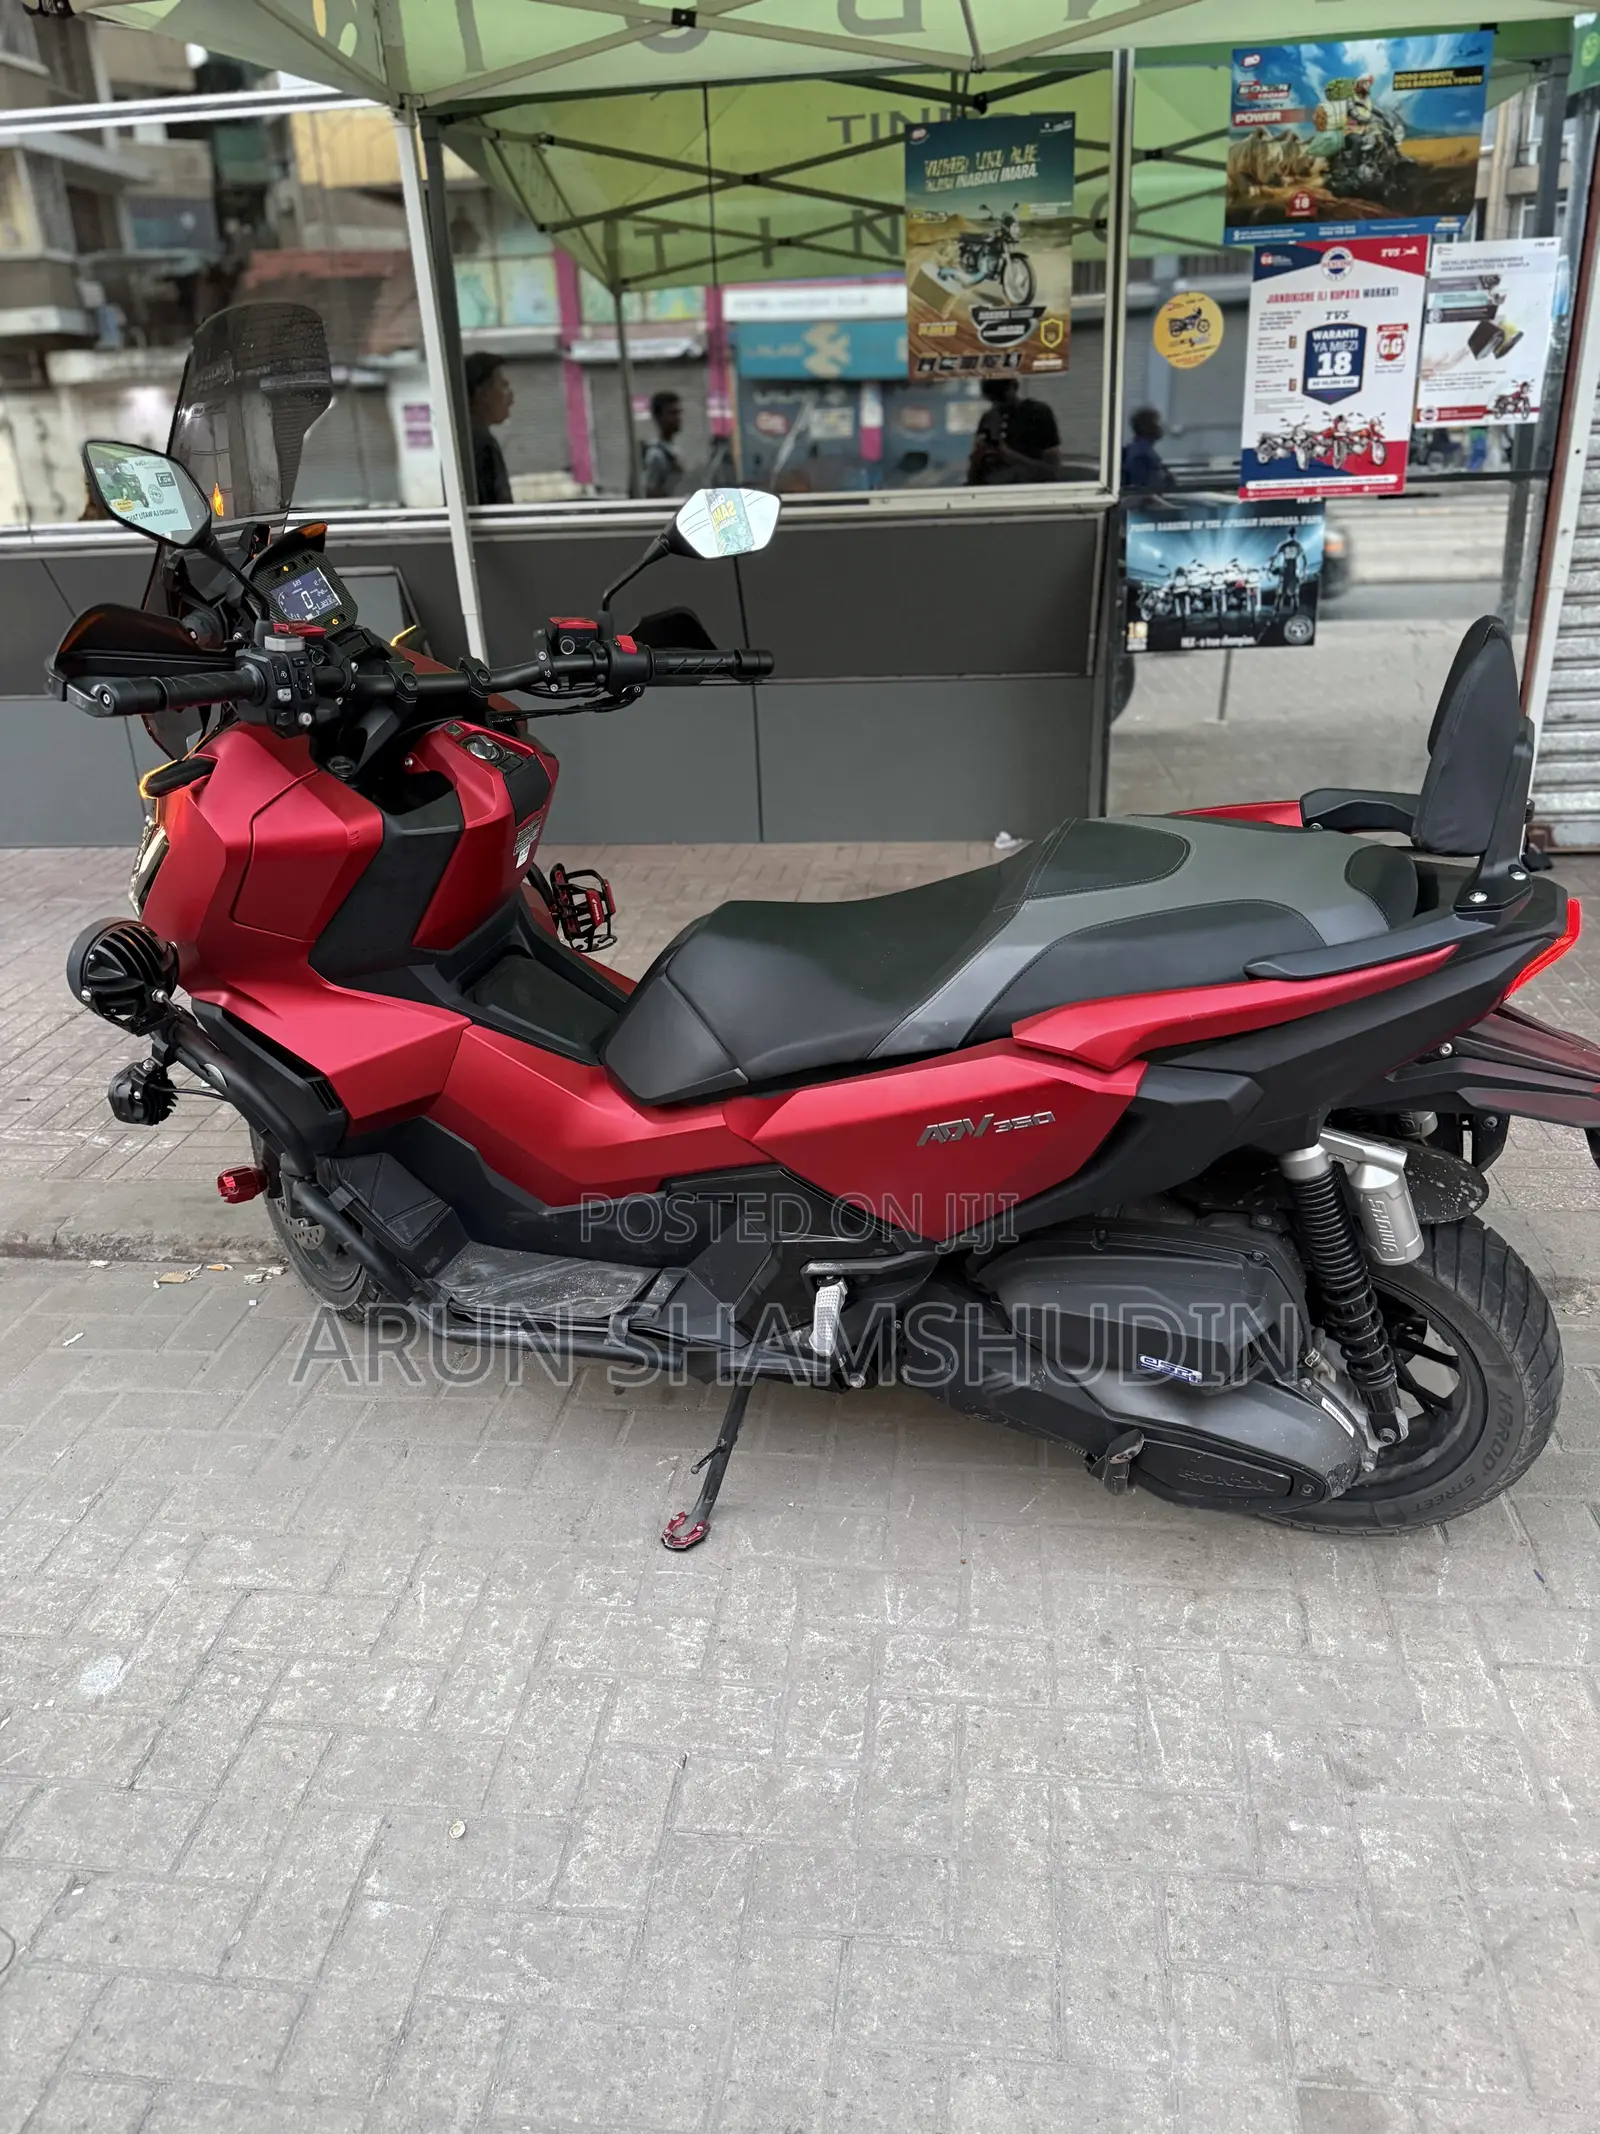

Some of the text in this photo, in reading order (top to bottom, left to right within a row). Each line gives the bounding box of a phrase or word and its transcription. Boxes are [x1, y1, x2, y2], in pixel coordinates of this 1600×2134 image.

[1235, 111, 1282, 123] POWER
[956, 168, 999, 189] INABAKI
[1000, 164, 1039, 182] IMARA.
[1380, 247, 1401, 258] TVS
[1267, 287, 1399, 304] JIANDIKISHE ILI KUPATA WARANTI
[1325, 310, 1350, 321] TVS
[1312, 328, 1359, 341] WARANTI
[1312, 340, 1359, 353] YA MIEZI
[1317, 352, 1352, 377] 18
[1192, 520, 1203, 530] OF
[1259, 516, 1299, 526] FOOTBALL
[1206, 637, 1220, 647] true
[916, 1111, 1056, 1147] ADV 350
[1367, 1198, 1400, 1253] SHOWA
[1413, 1473, 1477, 1512] STREET
